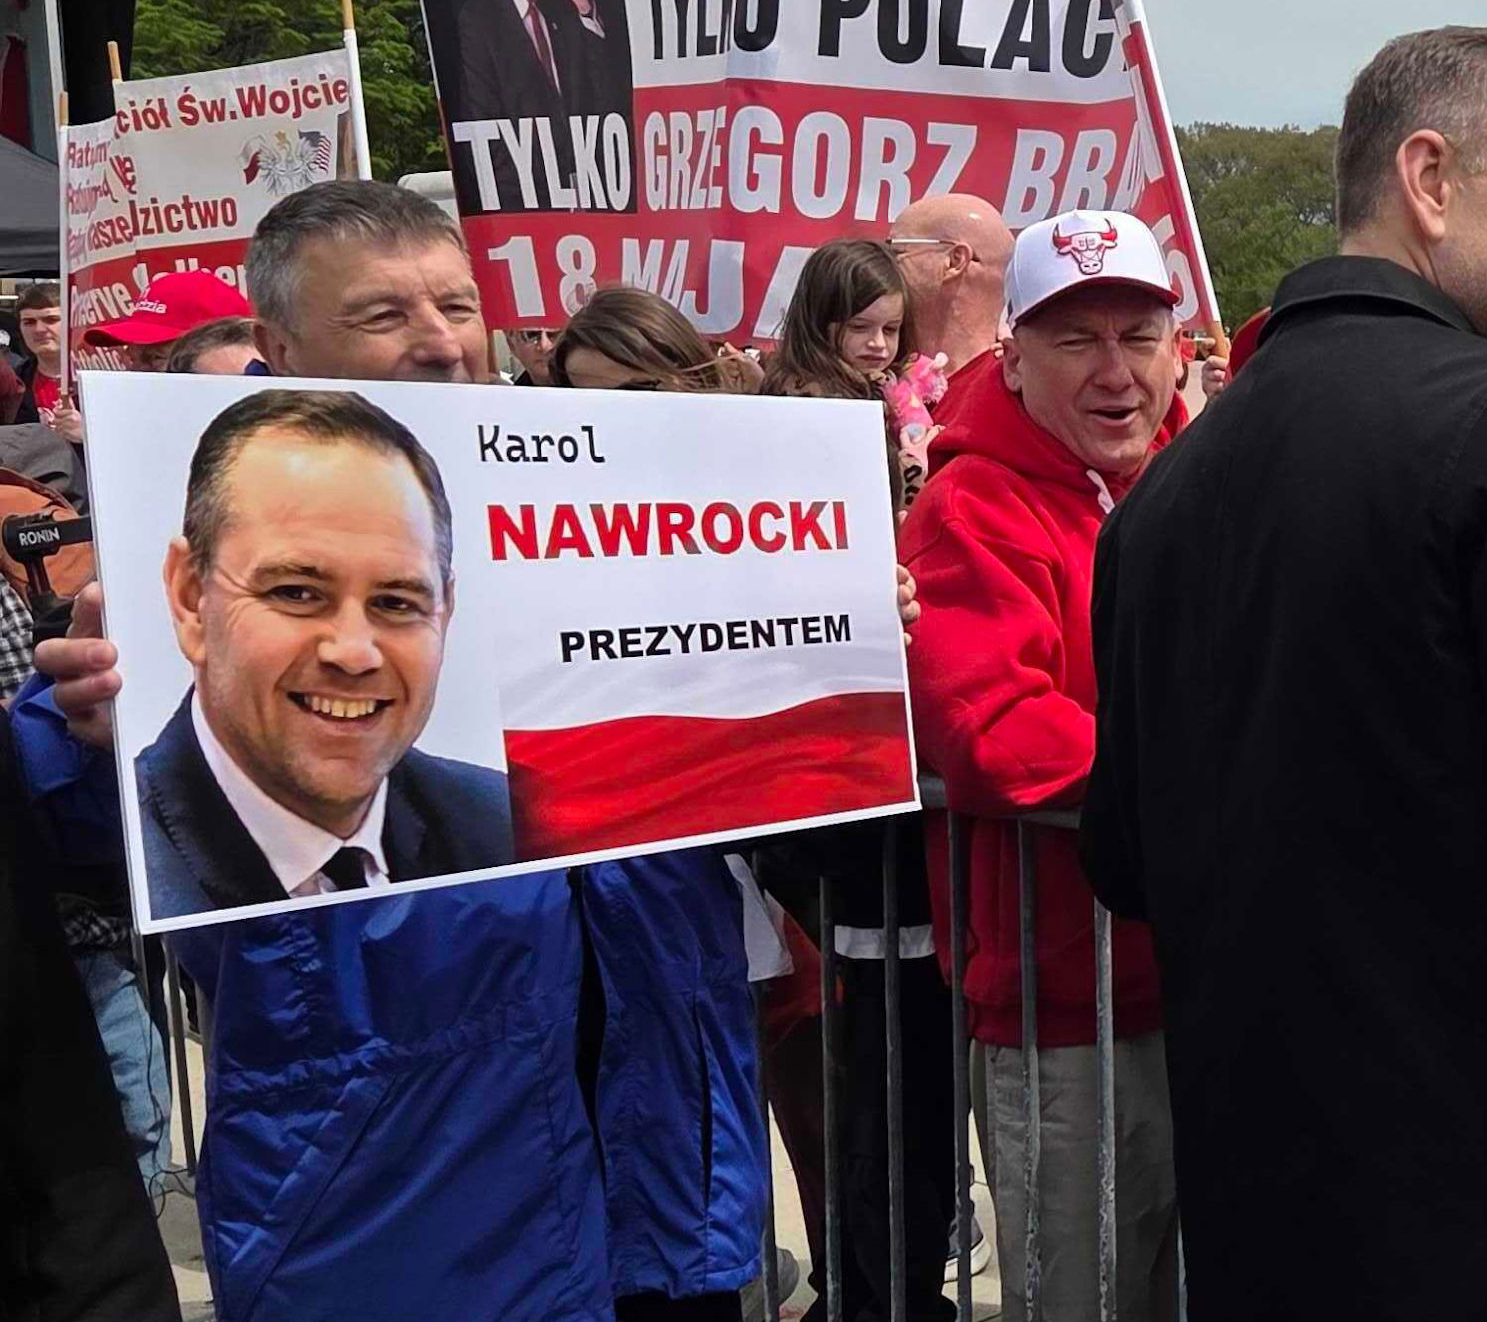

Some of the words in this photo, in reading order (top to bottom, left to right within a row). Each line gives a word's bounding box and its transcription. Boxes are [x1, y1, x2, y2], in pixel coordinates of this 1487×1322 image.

[115, 97, 172, 139] ciół
[452, 111, 631, 213] TYLKO
[644, 105, 978, 223] GRZEGORZ
[488, 234, 598, 318] 18
[477, 423, 606, 464] Karol
[18, 527, 61, 547] RONIN
[486, 501, 849, 561] NAWROCKI
[560, 613, 852, 664] PREZYDENTEM
